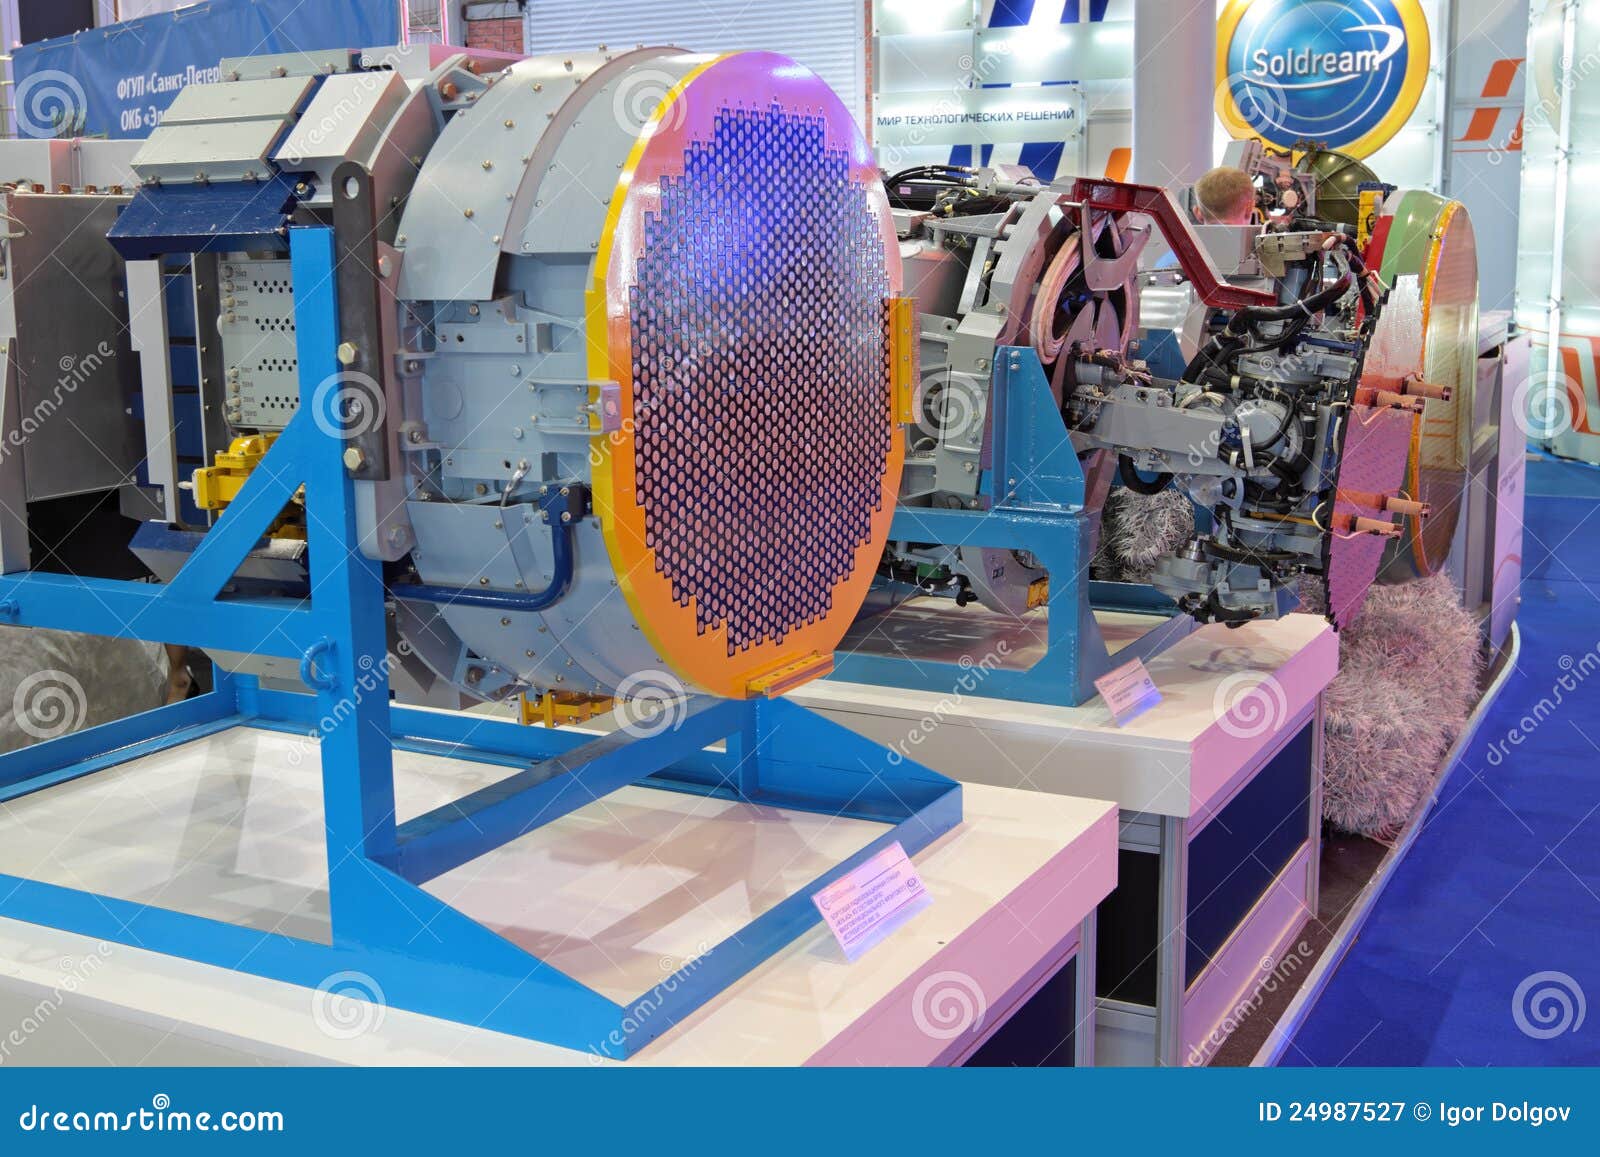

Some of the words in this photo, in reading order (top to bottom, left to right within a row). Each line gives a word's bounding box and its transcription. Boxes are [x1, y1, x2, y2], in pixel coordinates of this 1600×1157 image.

[1253, 47, 1380, 77] Soldream
[117, 75, 145, 101] ФГУП
[120, 108, 142, 132] ОКБ
[877, 116, 902, 126] МИР
[905, 111, 1013, 126] ТЕХНОЛОГИЧЕСКИХ
[1016, 109, 1075, 121] РЕШЕНИЙ
